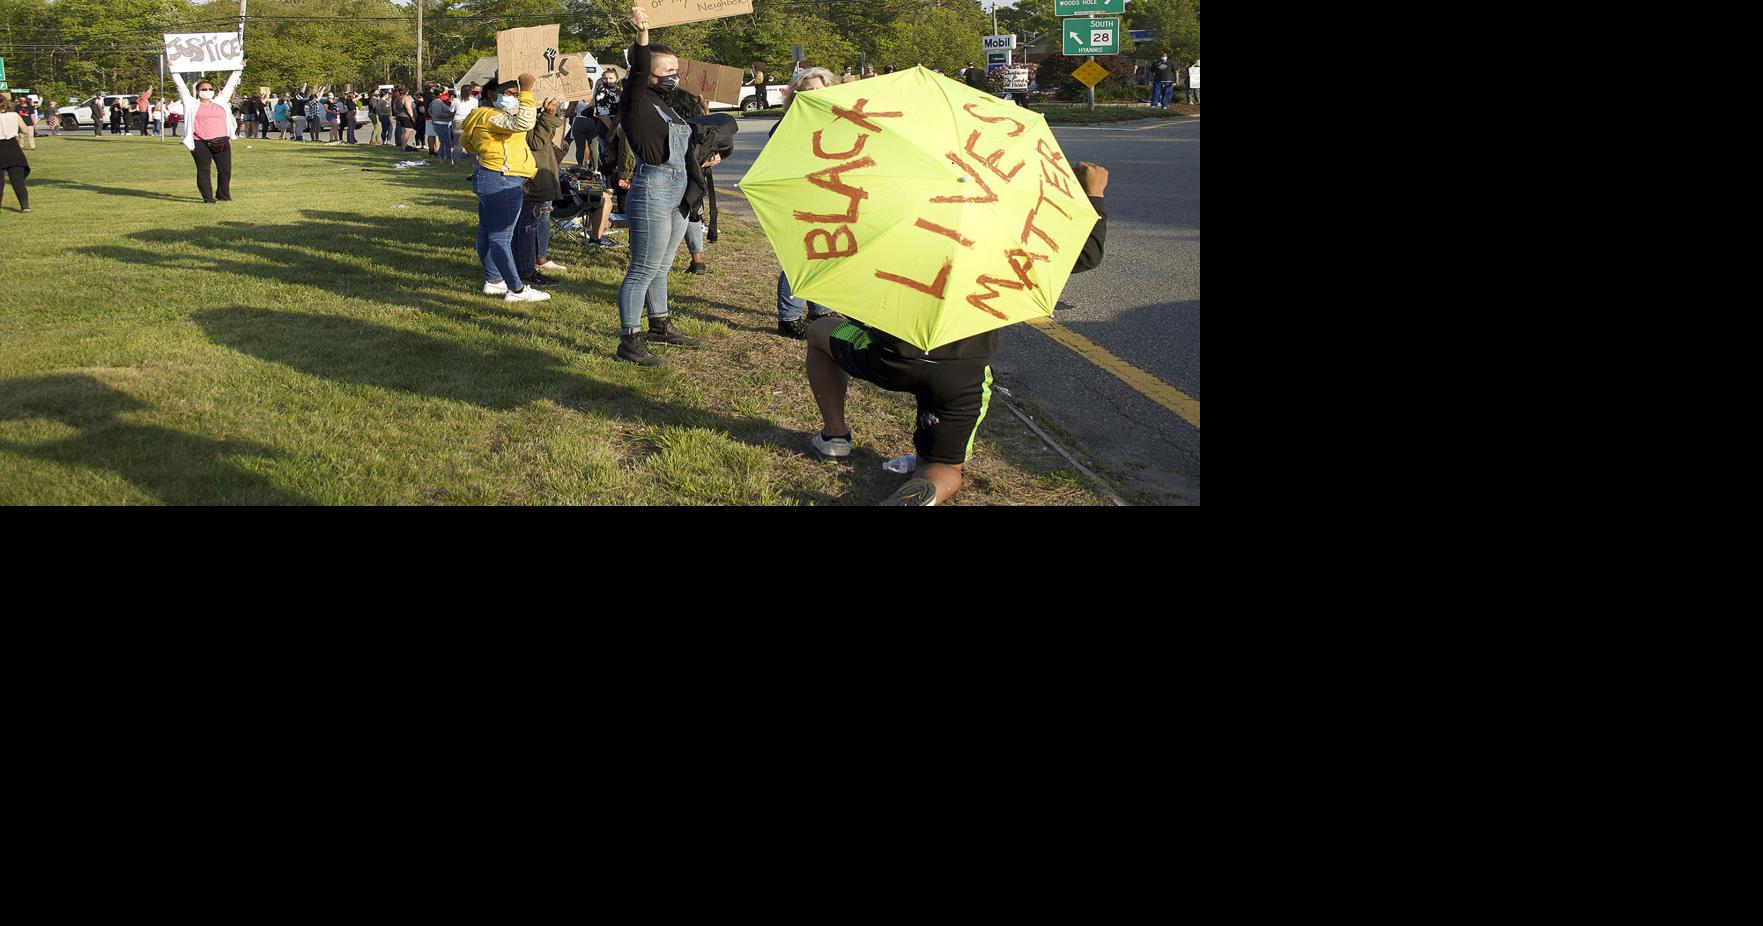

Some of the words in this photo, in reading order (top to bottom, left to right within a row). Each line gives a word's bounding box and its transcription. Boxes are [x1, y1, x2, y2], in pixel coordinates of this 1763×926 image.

[984, 37, 1010, 48] Mobil
[1090, 20, 1114, 28] SOUTH
[1093, 33, 1110, 43] 28
[793, 98, 904, 260] BLACK
[874, 103, 1026, 300] LIVES
[966, 137, 1076, 321] MATTER
